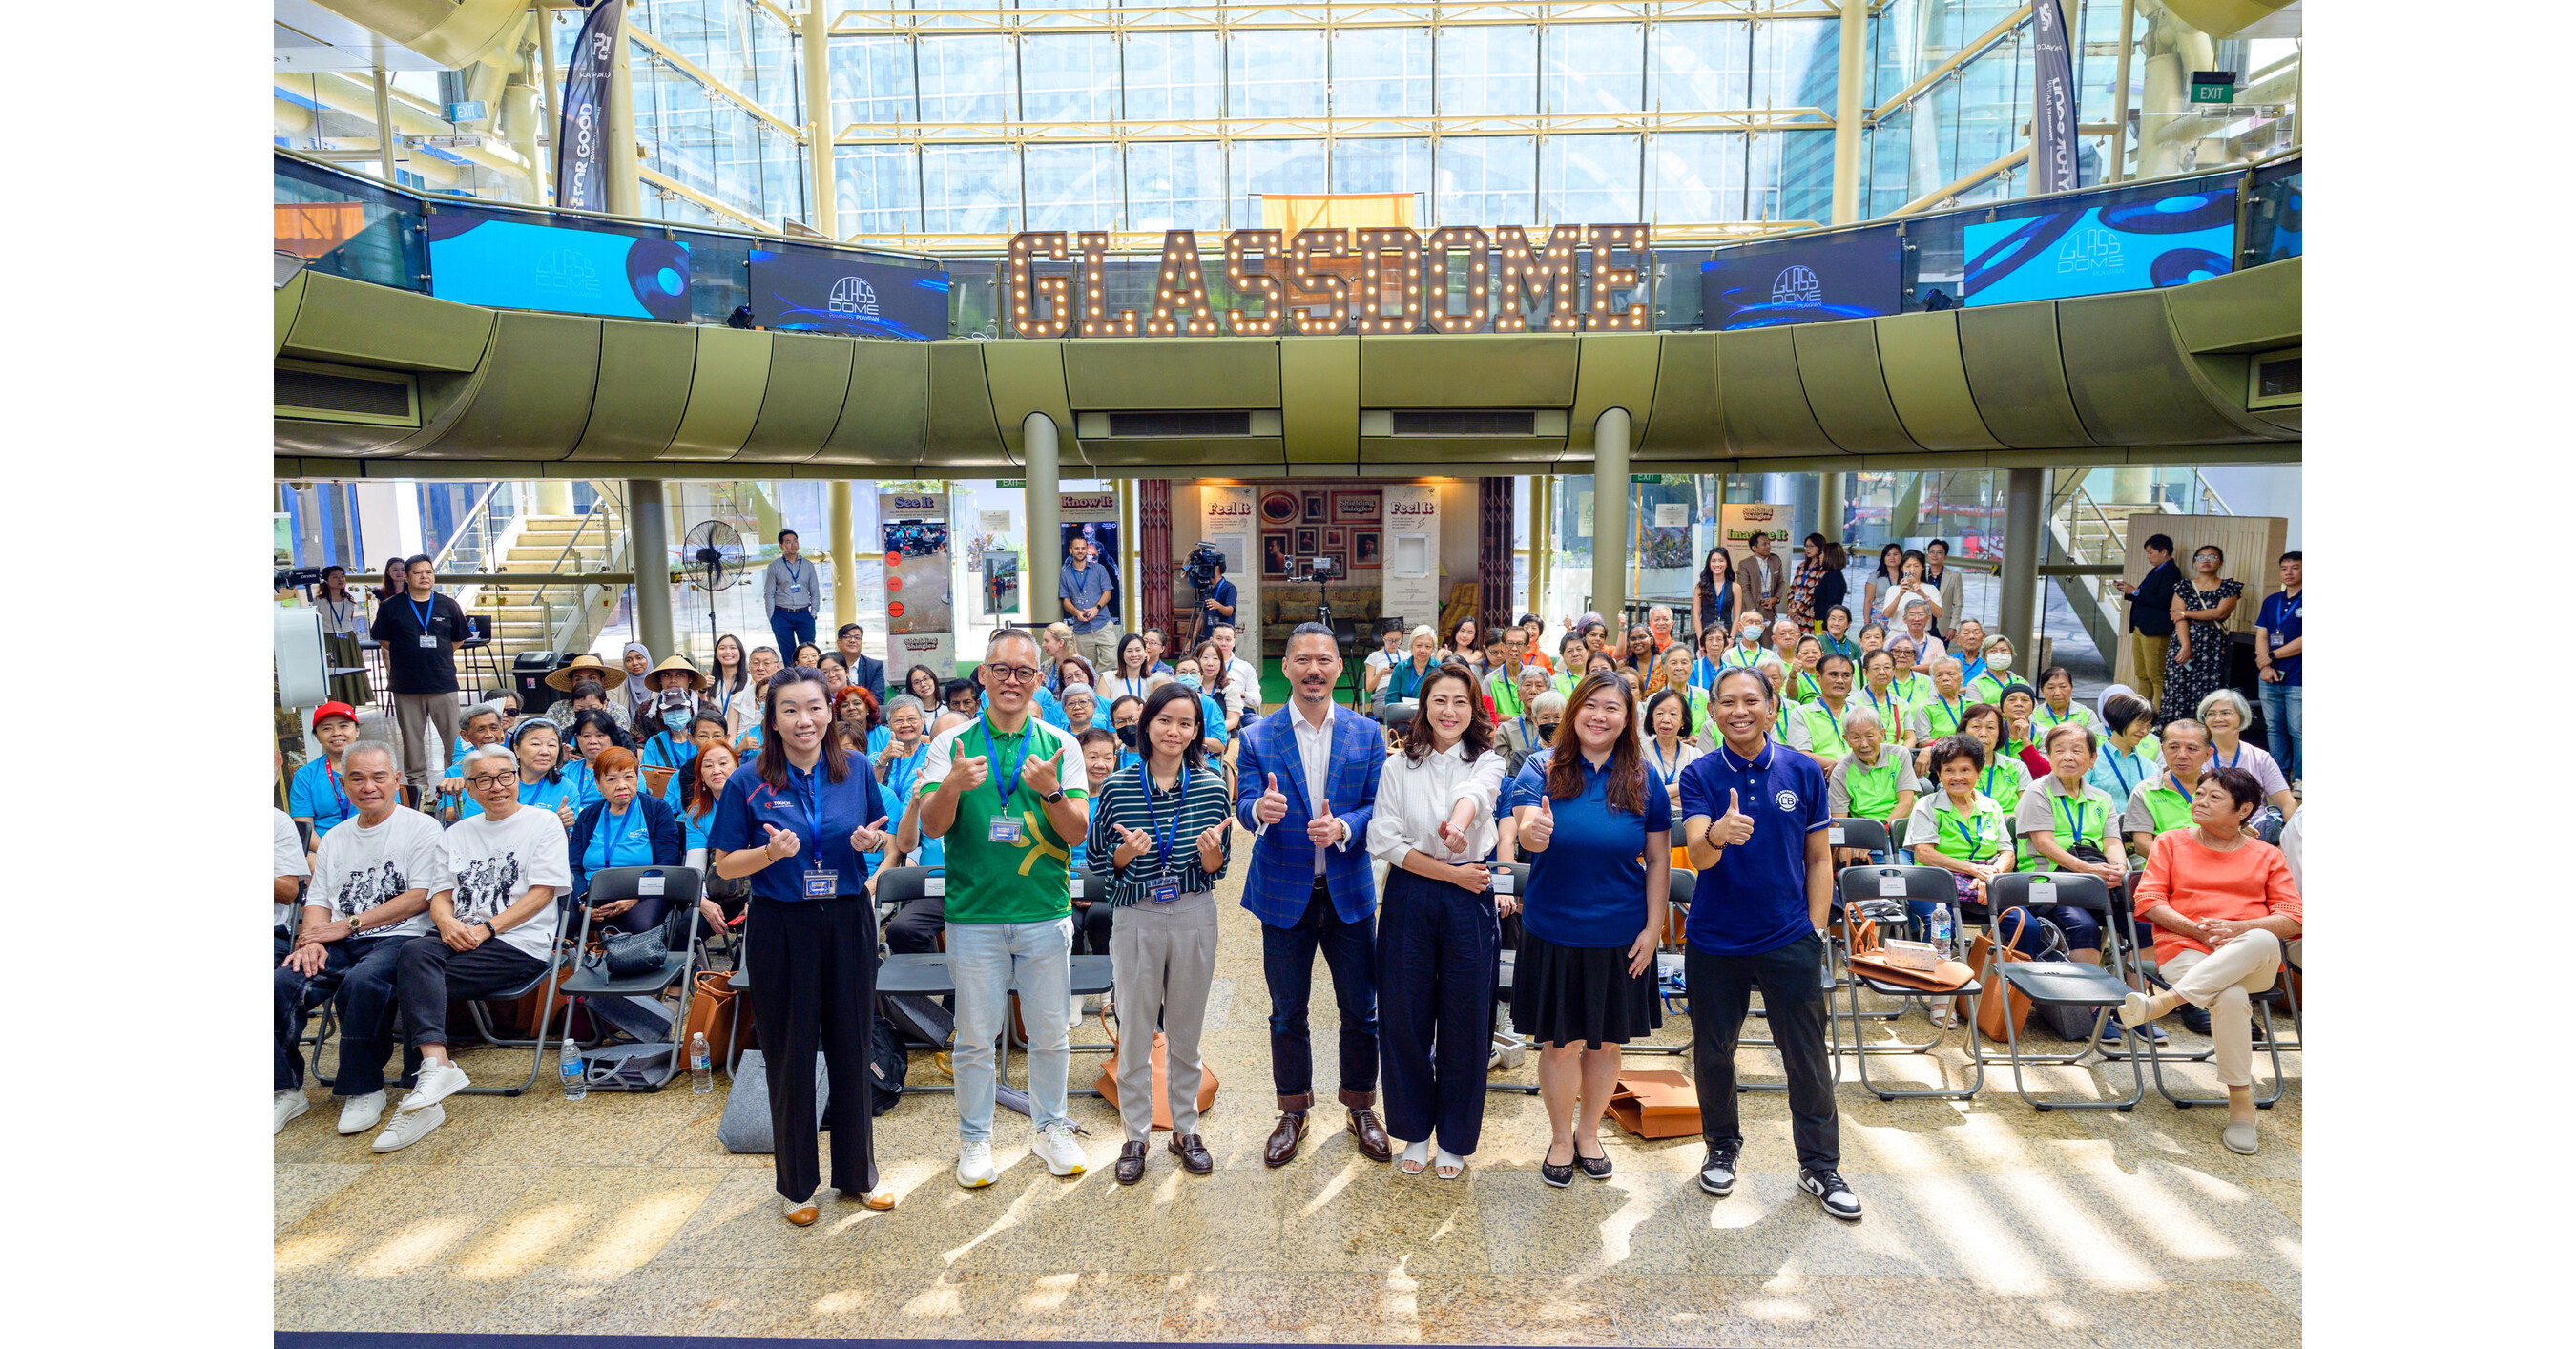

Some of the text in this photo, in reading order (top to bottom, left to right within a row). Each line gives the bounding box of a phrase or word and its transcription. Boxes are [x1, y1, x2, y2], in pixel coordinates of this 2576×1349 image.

[2200, 87, 2224, 99] EXIT
[457, 104, 475, 118] EXIT
[577, 103, 592, 158] GOOD
[2059, 227, 2120, 259] GLASS
[536, 246, 595, 278] GLASS
[2058, 254, 2124, 273] DOME
[535, 274, 601, 291] DOME
[1008, 222, 1650, 338] GLASSDOME
[1772, 265, 1818, 294] GLASS
[829, 276, 876, 303] GLASS
[1772, 289, 1821, 305] DOME
[829, 301, 879, 315] DOME
[894, 496, 934, 509] See It
[1061, 495, 1113, 508] Know It
[1208, 502, 1251, 515] Feel It
[1340, 499, 1376, 508] Shielding
[1390, 501, 1434, 515] Feel It
[1340, 505, 1374, 514] Shingles
[1776, 529, 1789, 542] It
